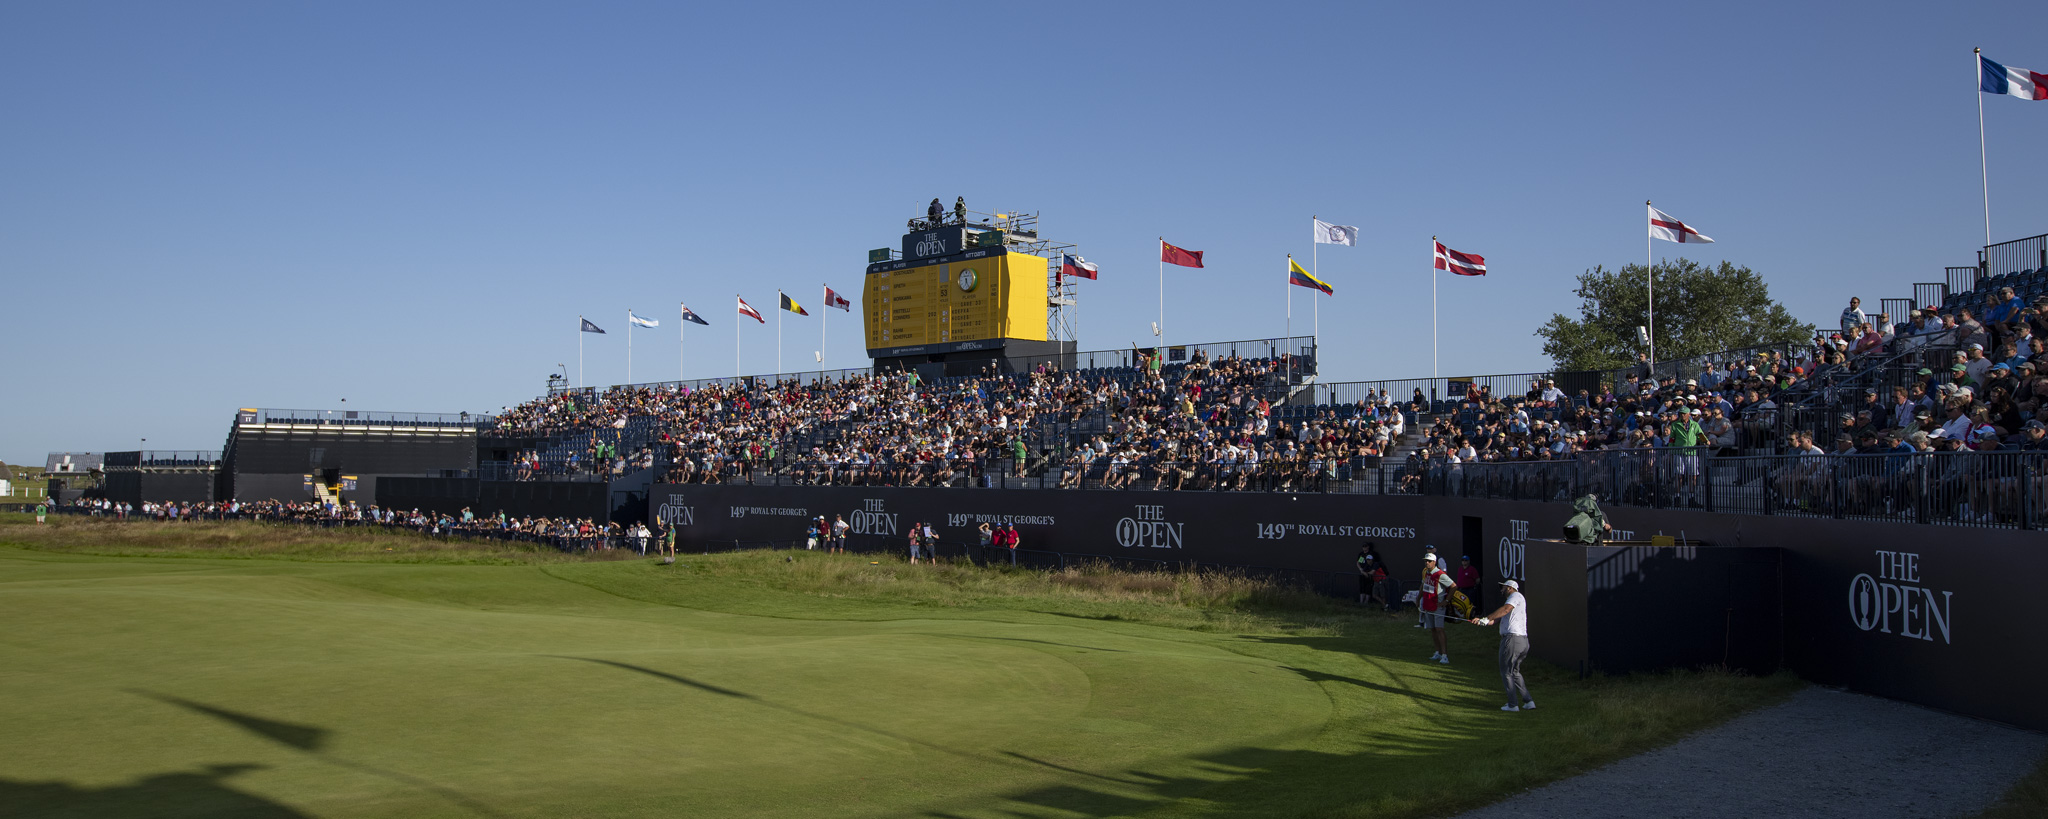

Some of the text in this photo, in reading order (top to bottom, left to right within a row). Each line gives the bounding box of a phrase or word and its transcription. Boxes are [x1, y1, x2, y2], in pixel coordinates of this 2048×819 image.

[924, 233, 938, 241] THE
[916, 240, 946, 257] OPEN
[669, 494, 684, 505] THE
[863, 499, 884, 512] THE
[658, 503, 694, 525] OPEN
[750, 506, 769, 515] ROYAL
[770, 507, 778, 515] ST
[778, 508, 807, 516] GEORGE'S
[1135, 505, 1164, 521] THE
[850, 509, 898, 535] OPEN
[947, 513, 1055, 527] 149TH ROYAL ST GEORGE'S
[1115, 517, 1184, 549] OPEN
[1257, 523, 1415, 539] 149TH ROYAL ST GEORGE'S
[1510, 519, 1529, 541] THE
[1876, 550, 1920, 583] THE
[1849, 573, 1953, 645] OPEN
